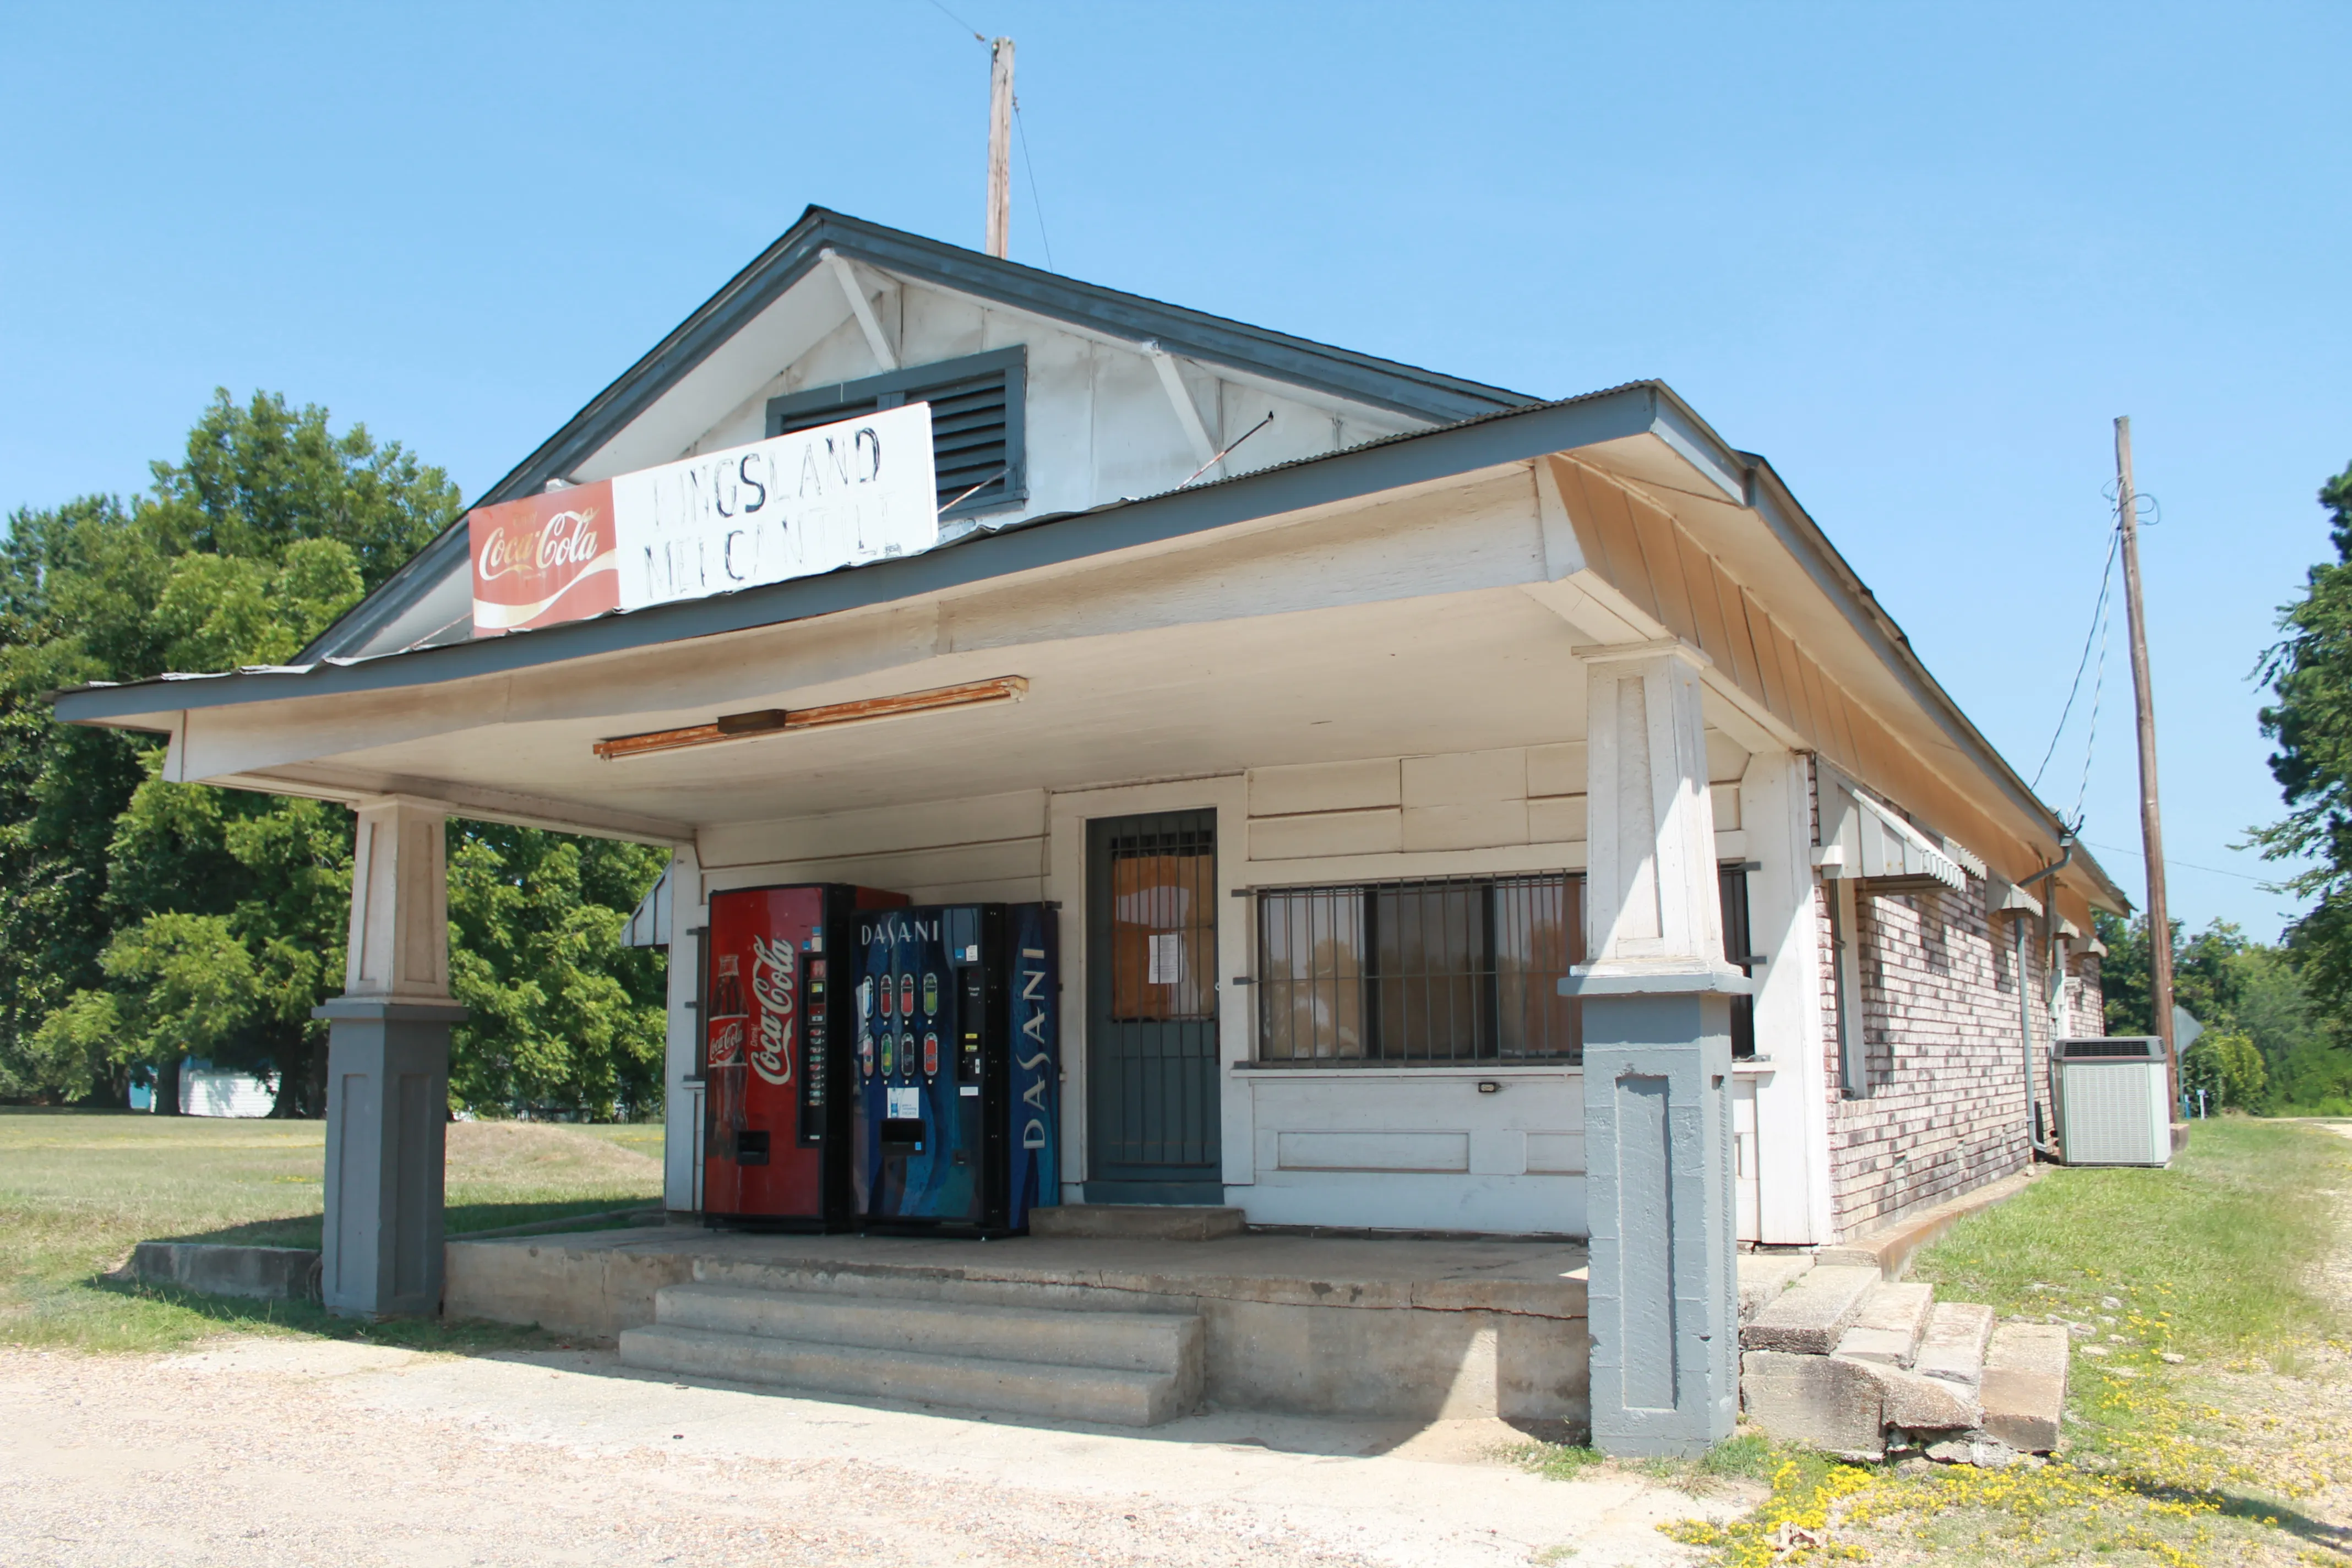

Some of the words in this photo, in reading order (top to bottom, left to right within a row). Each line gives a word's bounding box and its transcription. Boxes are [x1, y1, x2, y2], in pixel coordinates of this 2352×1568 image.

[654, 427, 881, 532] INGSLAND
[479, 506, 601, 581] Coca-Cola
[861, 916, 938, 949] DASANI
[710, 1020, 743, 1061] Coca-Cola
[750, 934, 794, 1085] Coca-Cola
[1016, 948, 1051, 1150] DASANI
